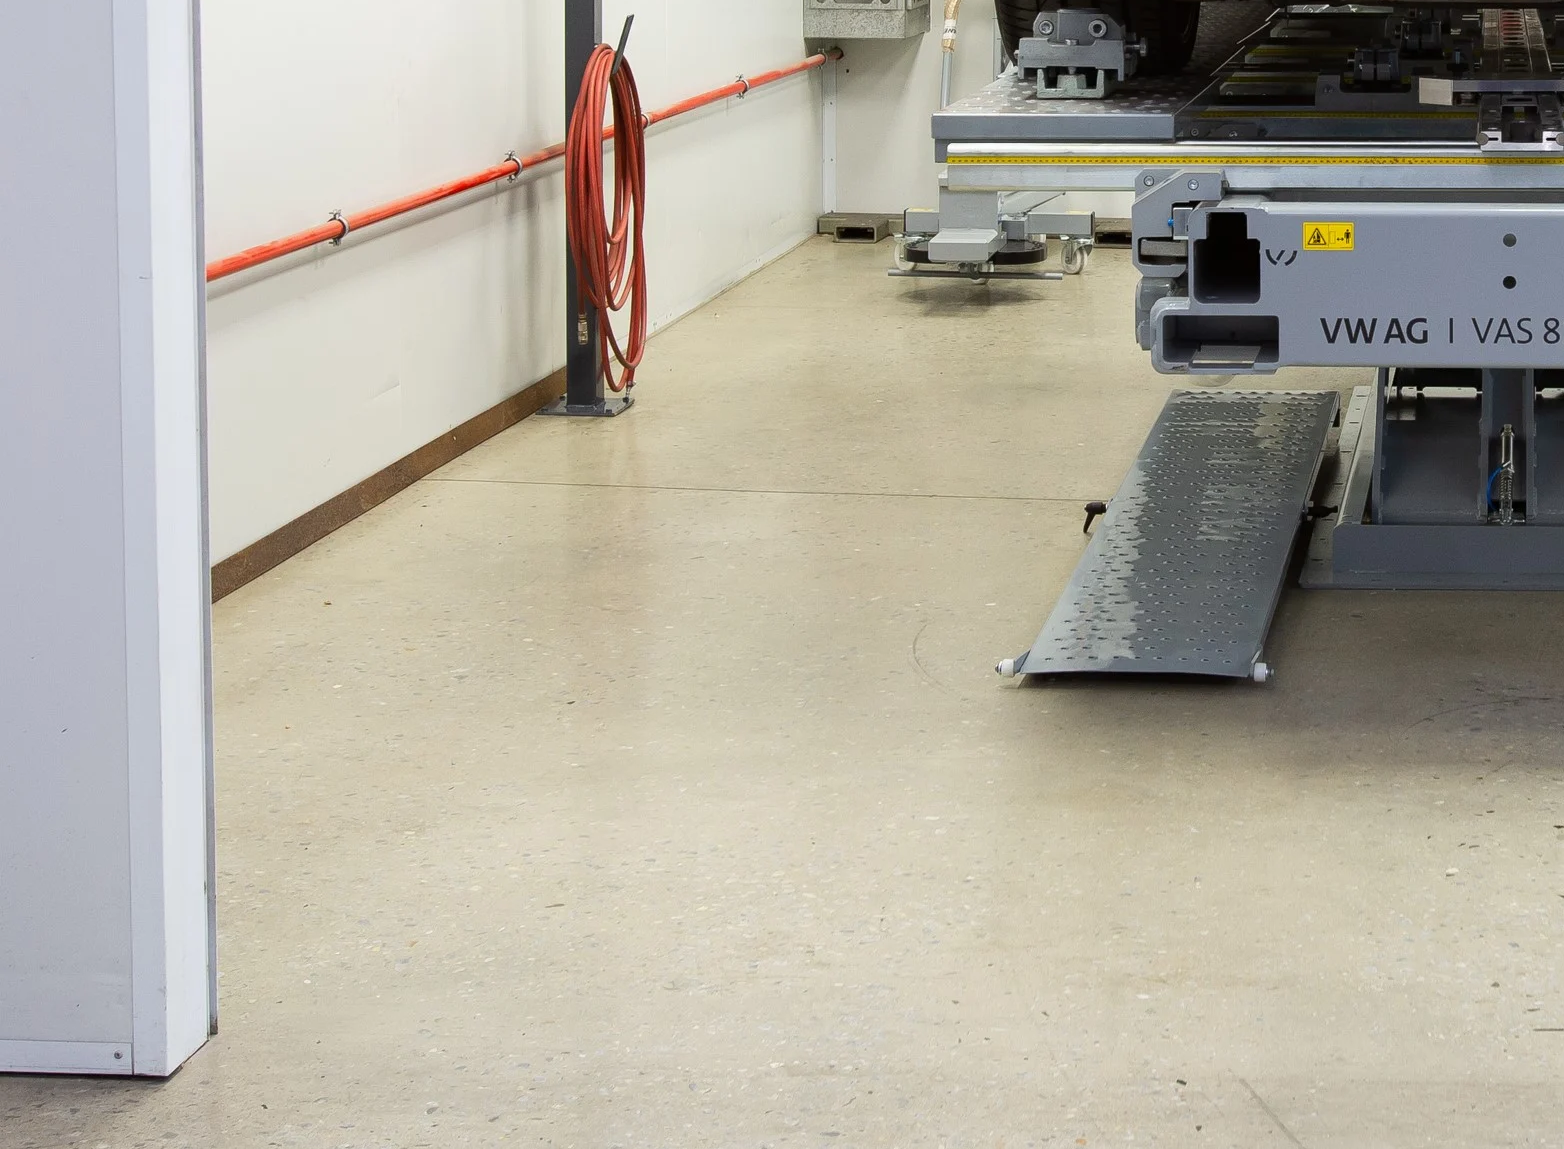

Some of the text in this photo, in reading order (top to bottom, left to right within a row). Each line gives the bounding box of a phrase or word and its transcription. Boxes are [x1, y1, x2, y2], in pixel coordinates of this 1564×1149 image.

[1320, 317, 1378, 344] VW
[1383, 317, 1429, 344] AG
[1471, 317, 1533, 344] VAS
